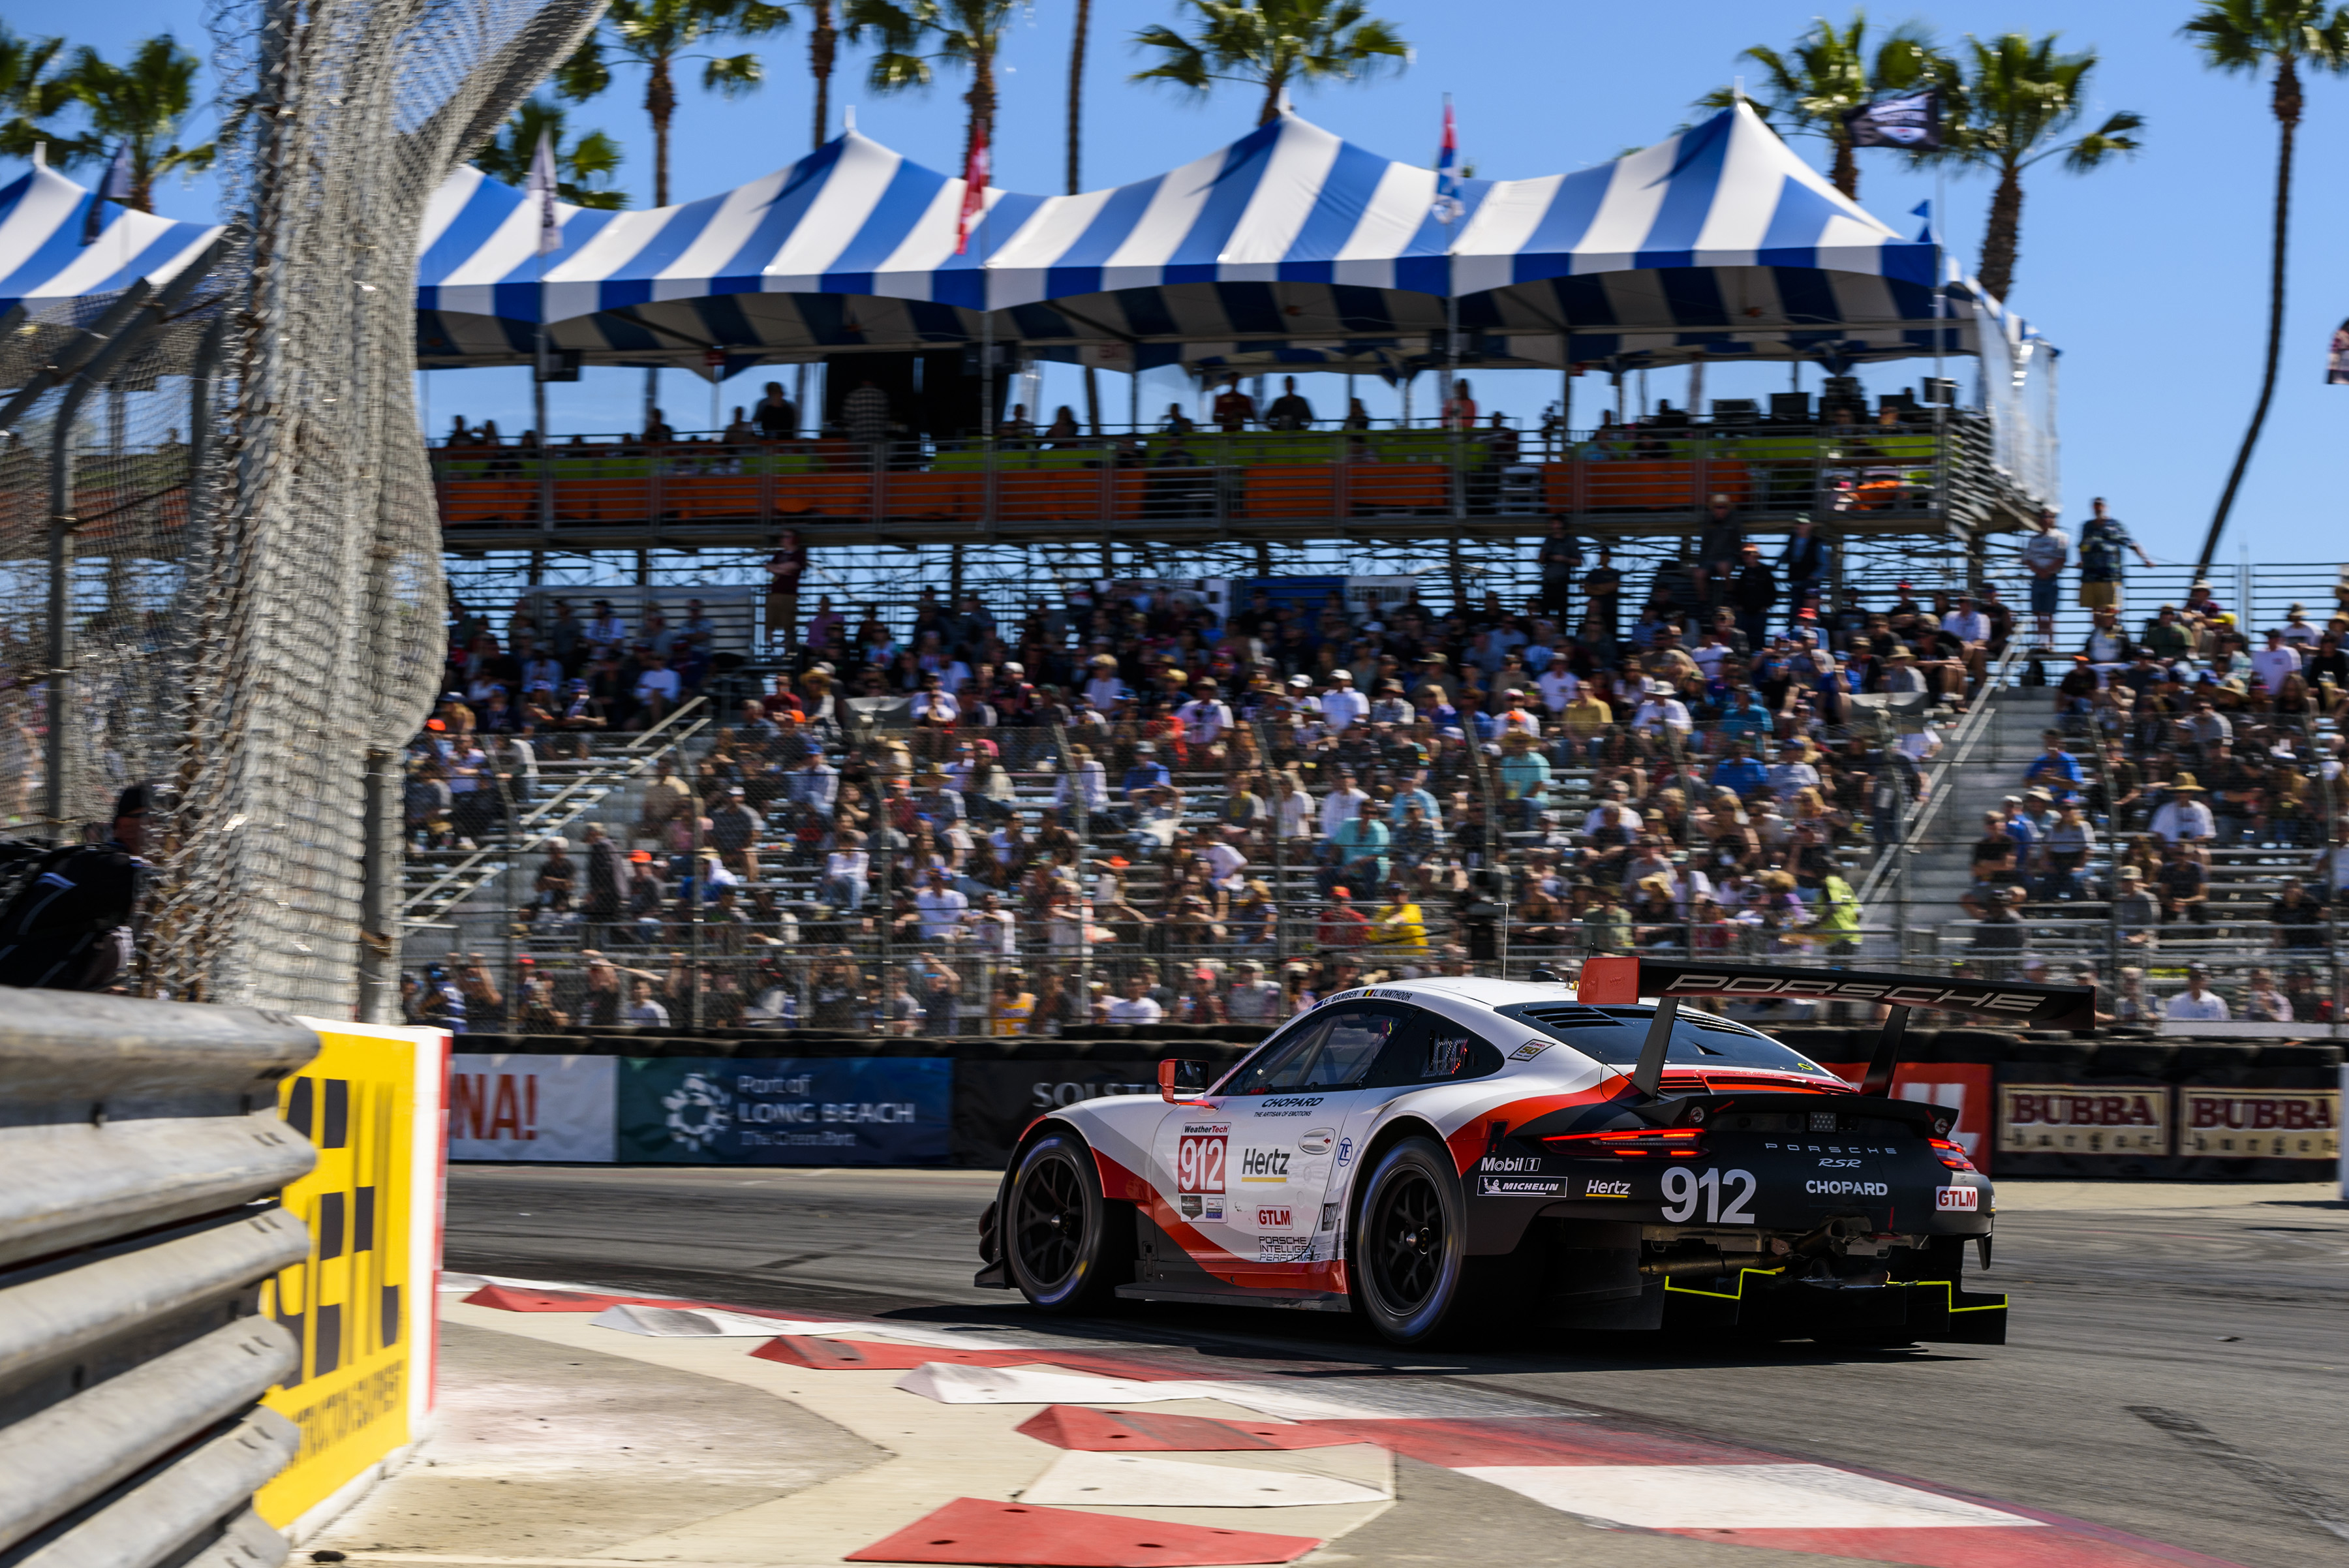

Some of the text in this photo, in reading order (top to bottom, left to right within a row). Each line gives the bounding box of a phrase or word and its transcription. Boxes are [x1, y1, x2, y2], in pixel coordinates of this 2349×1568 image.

[1331, 990, 1359, 1003] BAMBER
[1380, 989, 1413, 1002] VANTHOOR
[1665, 974, 2048, 1013] PORSCHE
[1518, 1045, 1541, 1055] 50
[1261, 1098, 1325, 1108] CHOPARD
[2007, 1094, 2160, 1126] BUBBA
[737, 1103, 915, 1123] LONG BEACH
[2188, 1098, 2336, 1130] BUBBA
[1184, 1125, 1229, 1133] WeatherTech
[1338, 1143, 1352, 1161] ZF
[1764, 1143, 1897, 1154] PORSCHE
[1180, 1138, 1224, 1191] 912
[1242, 1148, 1291, 1175] Hertz
[1481, 1158, 1524, 1171] Mobil
[1818, 1158, 1862, 1168] RSR
[1502, 1182, 1559, 1191] MICHELIN
[1586, 1180, 1631, 1195] Hertz
[1805, 1180, 1888, 1196] CHOPARD
[1661, 1166, 1757, 1224] 912
[1938, 1190, 1976, 1207] GTLM
[1259, 1209, 1291, 1225] GTLM
[1259, 1236, 1307, 1244] PORSCHE
[1259, 1244, 1316, 1253] INTELLIGENT
[1259, 1253, 1321, 1262] PERFORMACE
